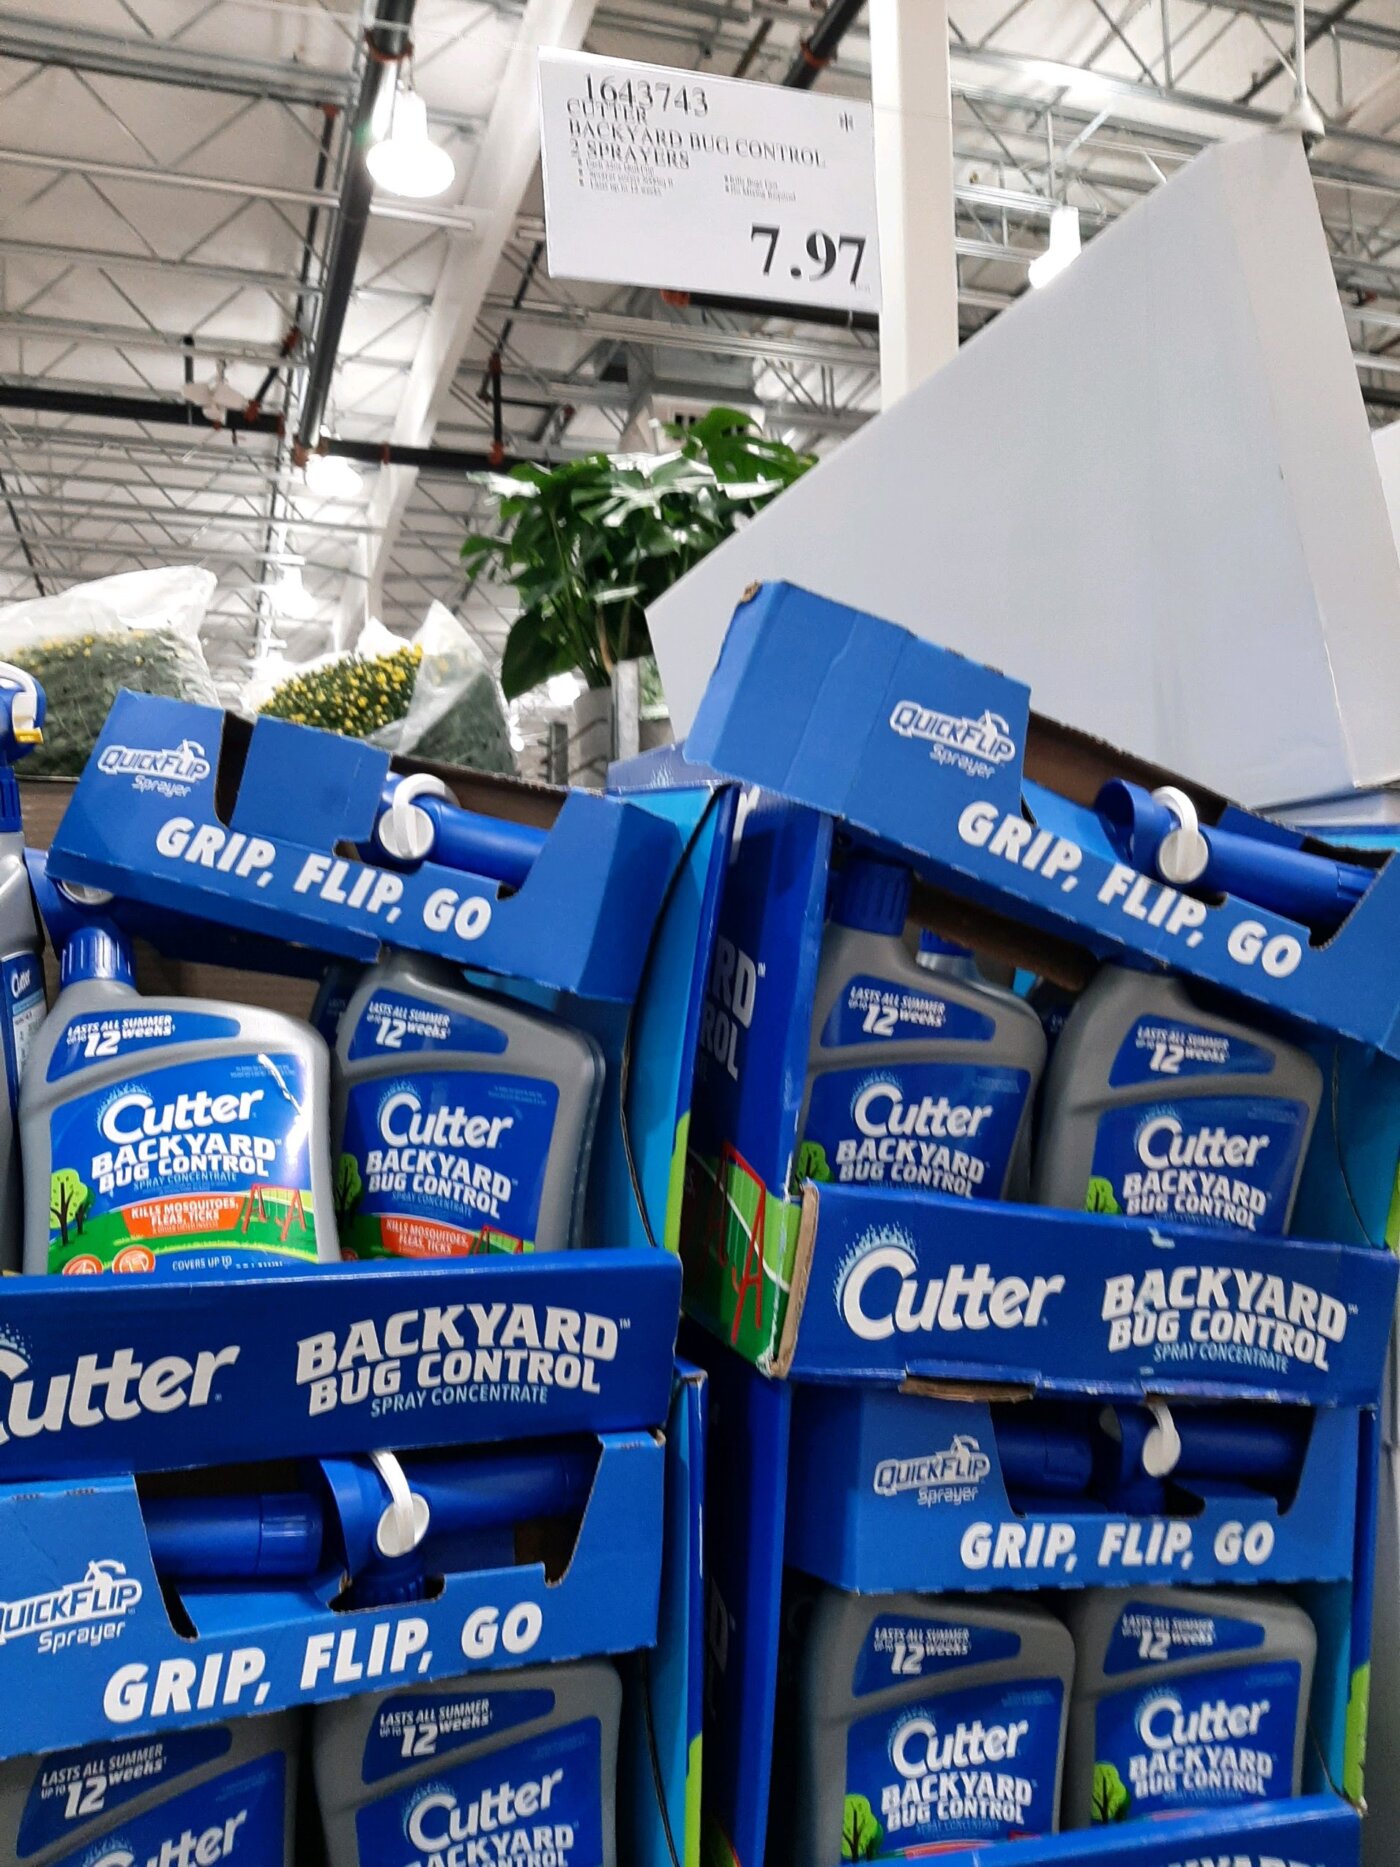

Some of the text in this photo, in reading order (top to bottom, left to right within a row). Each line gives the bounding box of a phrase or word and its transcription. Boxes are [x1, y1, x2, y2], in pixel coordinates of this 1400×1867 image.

[567, 98, 647, 124] CUTTER
[586, 73, 708, 117] 1643743
[569, 118, 825, 169] BACKYARD BUG CONTROL
[587, 140, 689, 169] SPRAYERS
[751, 223, 867, 286] 7.97
[890, 700, 1015, 764] QUICKFLIP
[98, 744, 210, 783] QUICKFLIP
[930, 743, 995, 779] Sprayer
[131, 775, 191, 798] Sprayer
[156, 817, 492, 941] GRIP, FLIP, GO
[957, 801, 1302, 979] GRIP, FLIP, GO
[68, 1015, 172, 1036] LASTS ALL SUMMER
[376, 1016, 406, 1049] 12
[862, 1003, 898, 1037] 12
[84, 1030, 121, 1058] 12
[1150, 1043, 1184, 1074] 12
[101, 1089, 264, 1144] Cutter
[380, 1091, 514, 1149] Cutter
[855, 1082, 993, 1137] Cutter
[91, 1133, 276, 1180] BACKYARD
[836, 1138, 985, 1185] BACKYARD
[1138, 1115, 1270, 1170] Cutter
[99, 1165, 149, 1196] BUG
[158, 1152, 270, 1179] CONTROL
[366, 1148, 512, 1202] BACKYARD
[839, 1161, 884, 1182] BUG
[891, 1163, 974, 1200] CONTROL
[1123, 1169, 1267, 1216] BACKYARD
[131, 1205, 161, 1219] KILLS
[368, 1174, 407, 1193] BUG
[412, 1174, 501, 1219] CONTROL
[1126, 1194, 1168, 1216] BUG
[1175, 1194, 1257, 1232] CONTROL
[172, 1257, 205, 1272] COVERS
[208, 1257, 220, 1268] UP
[843, 1246, 1066, 1340] Cutter
[1102, 1266, 1348, 1343] BACKYARD
[296, 1303, 618, 1385] BACKYARD
[1108, 1309, 1329, 1373] BUG CONTROL
[1153, 1343, 1289, 1375] SPRAY CONCENTRATE
[309, 1349, 600, 1417] BUG CONTROL
[370, 1384, 547, 1418] SPRAY CONCENTRATE
[873, 1451, 991, 1496] QUICKFLIP
[917, 1486, 979, 1508] Sprayer
[960, 1521, 1274, 1573] GRIP, FLIP, GO
[0, 1578, 142, 1642] UICKFLIP
[38, 1621, 125, 1654] Sprayer
[891, 1643, 924, 1675] 12
[1138, 1631, 1171, 1659] 12
[103, 1601, 543, 1723] GRIP, FLIP, GO
[380, 1698, 489, 1726] LASTS ALL SUMMER
[1140, 1696, 1270, 1750] Cutter
[401, 1723, 438, 1758] 12
[893, 1718, 1029, 1779] Cutter
[42, 1743, 163, 1787] LASTS ALL SUMMER
[1129, 1745, 1273, 1783] BACKYARD
[1135, 1773, 1176, 1799] BUG
[1183, 1769, 1266, 1796] CONTROL
[64, 1775, 107, 1819] 12
[409, 1768, 563, 1853] Cutter
[881, 1772, 1032, 1815] BACKYARD
[886, 1802, 931, 1832] BUG
[937, 1797, 1025, 1825] CONTROL
[403, 1824, 574, 1867] ACKYARD
